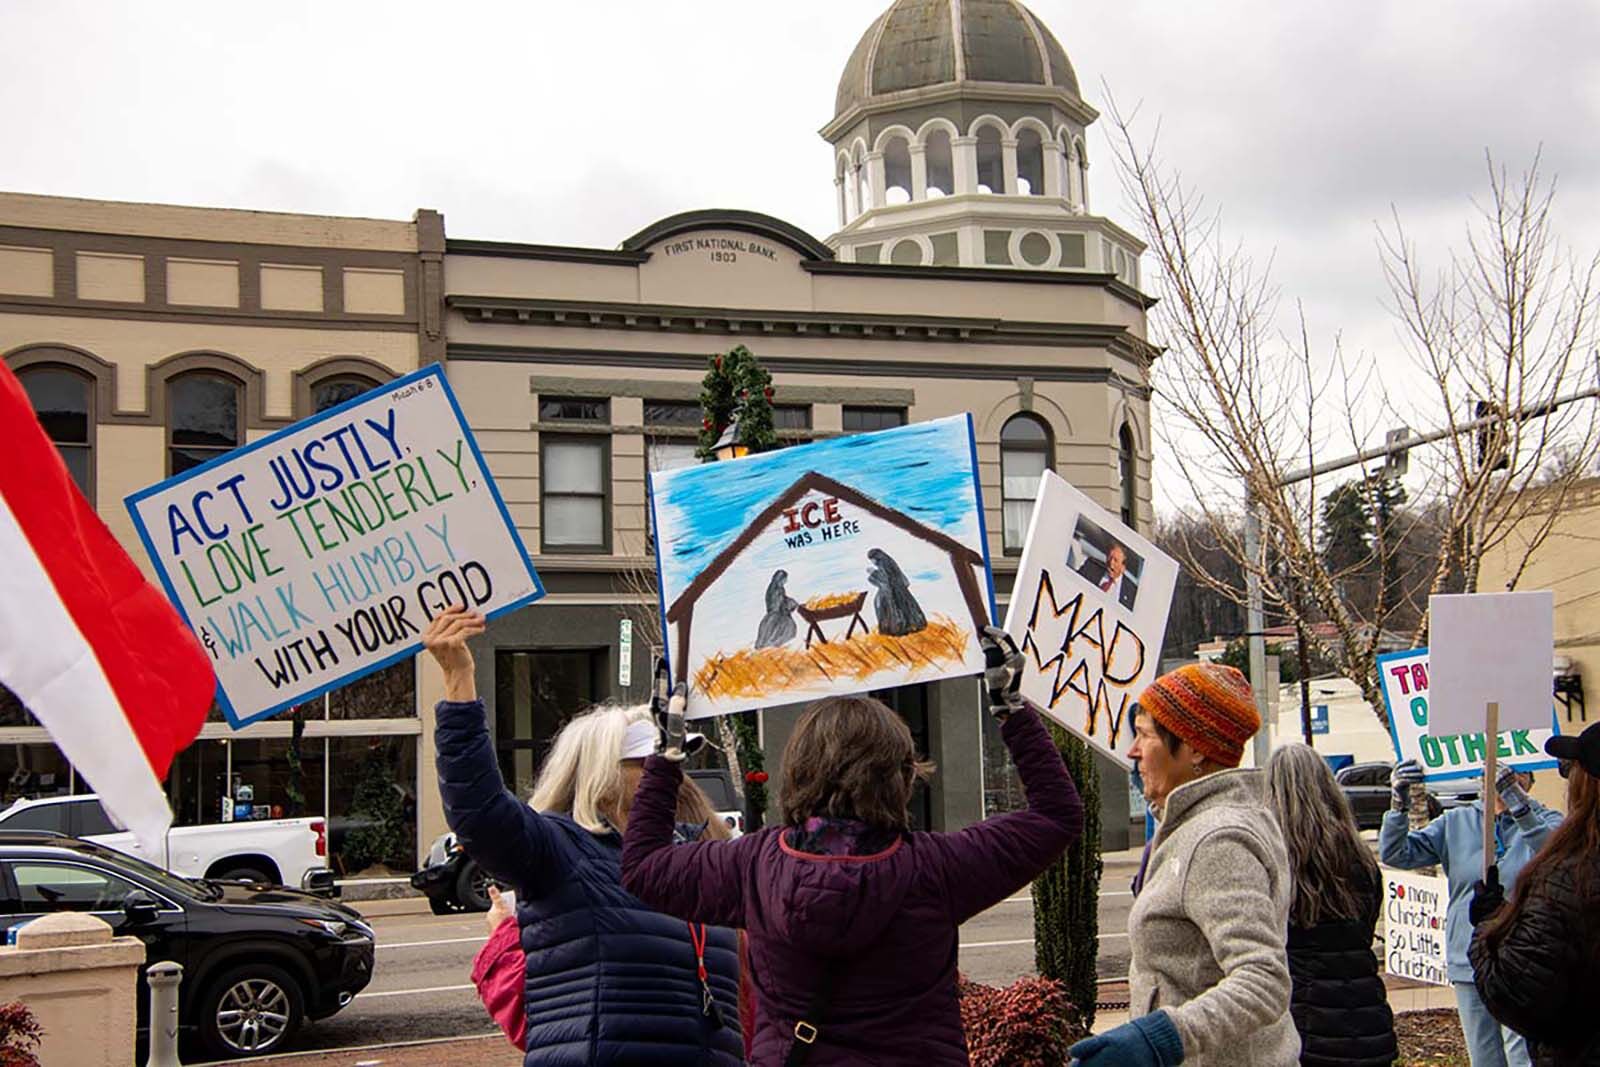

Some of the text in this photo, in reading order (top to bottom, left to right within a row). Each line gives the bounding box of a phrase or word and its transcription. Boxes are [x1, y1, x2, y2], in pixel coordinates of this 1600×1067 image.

[664, 239, 694, 256] FIRST
[696, 238, 746, 252] NATIONAL
[710, 252, 737, 263] 1903
[167, 408, 412, 555] ACT JUSTLY,
[180, 440, 478, 608] LOVE TENDERLY,
[785, 520, 860, 548] WAS HERE
[200, 514, 460, 660] & WALK HUMBLY
[255, 560, 494, 690] WITH YOUR GOD
[1027, 568, 1145, 684] MAD
[1022, 628, 1131, 751] MAN
[1391, 662, 1429, 695] TA
[1418, 728, 1539, 768] OTHER
[1408, 886, 1439, 912] many
[1409, 931, 1440, 956] Little
[1388, 951, 1450, 986] Christianit
